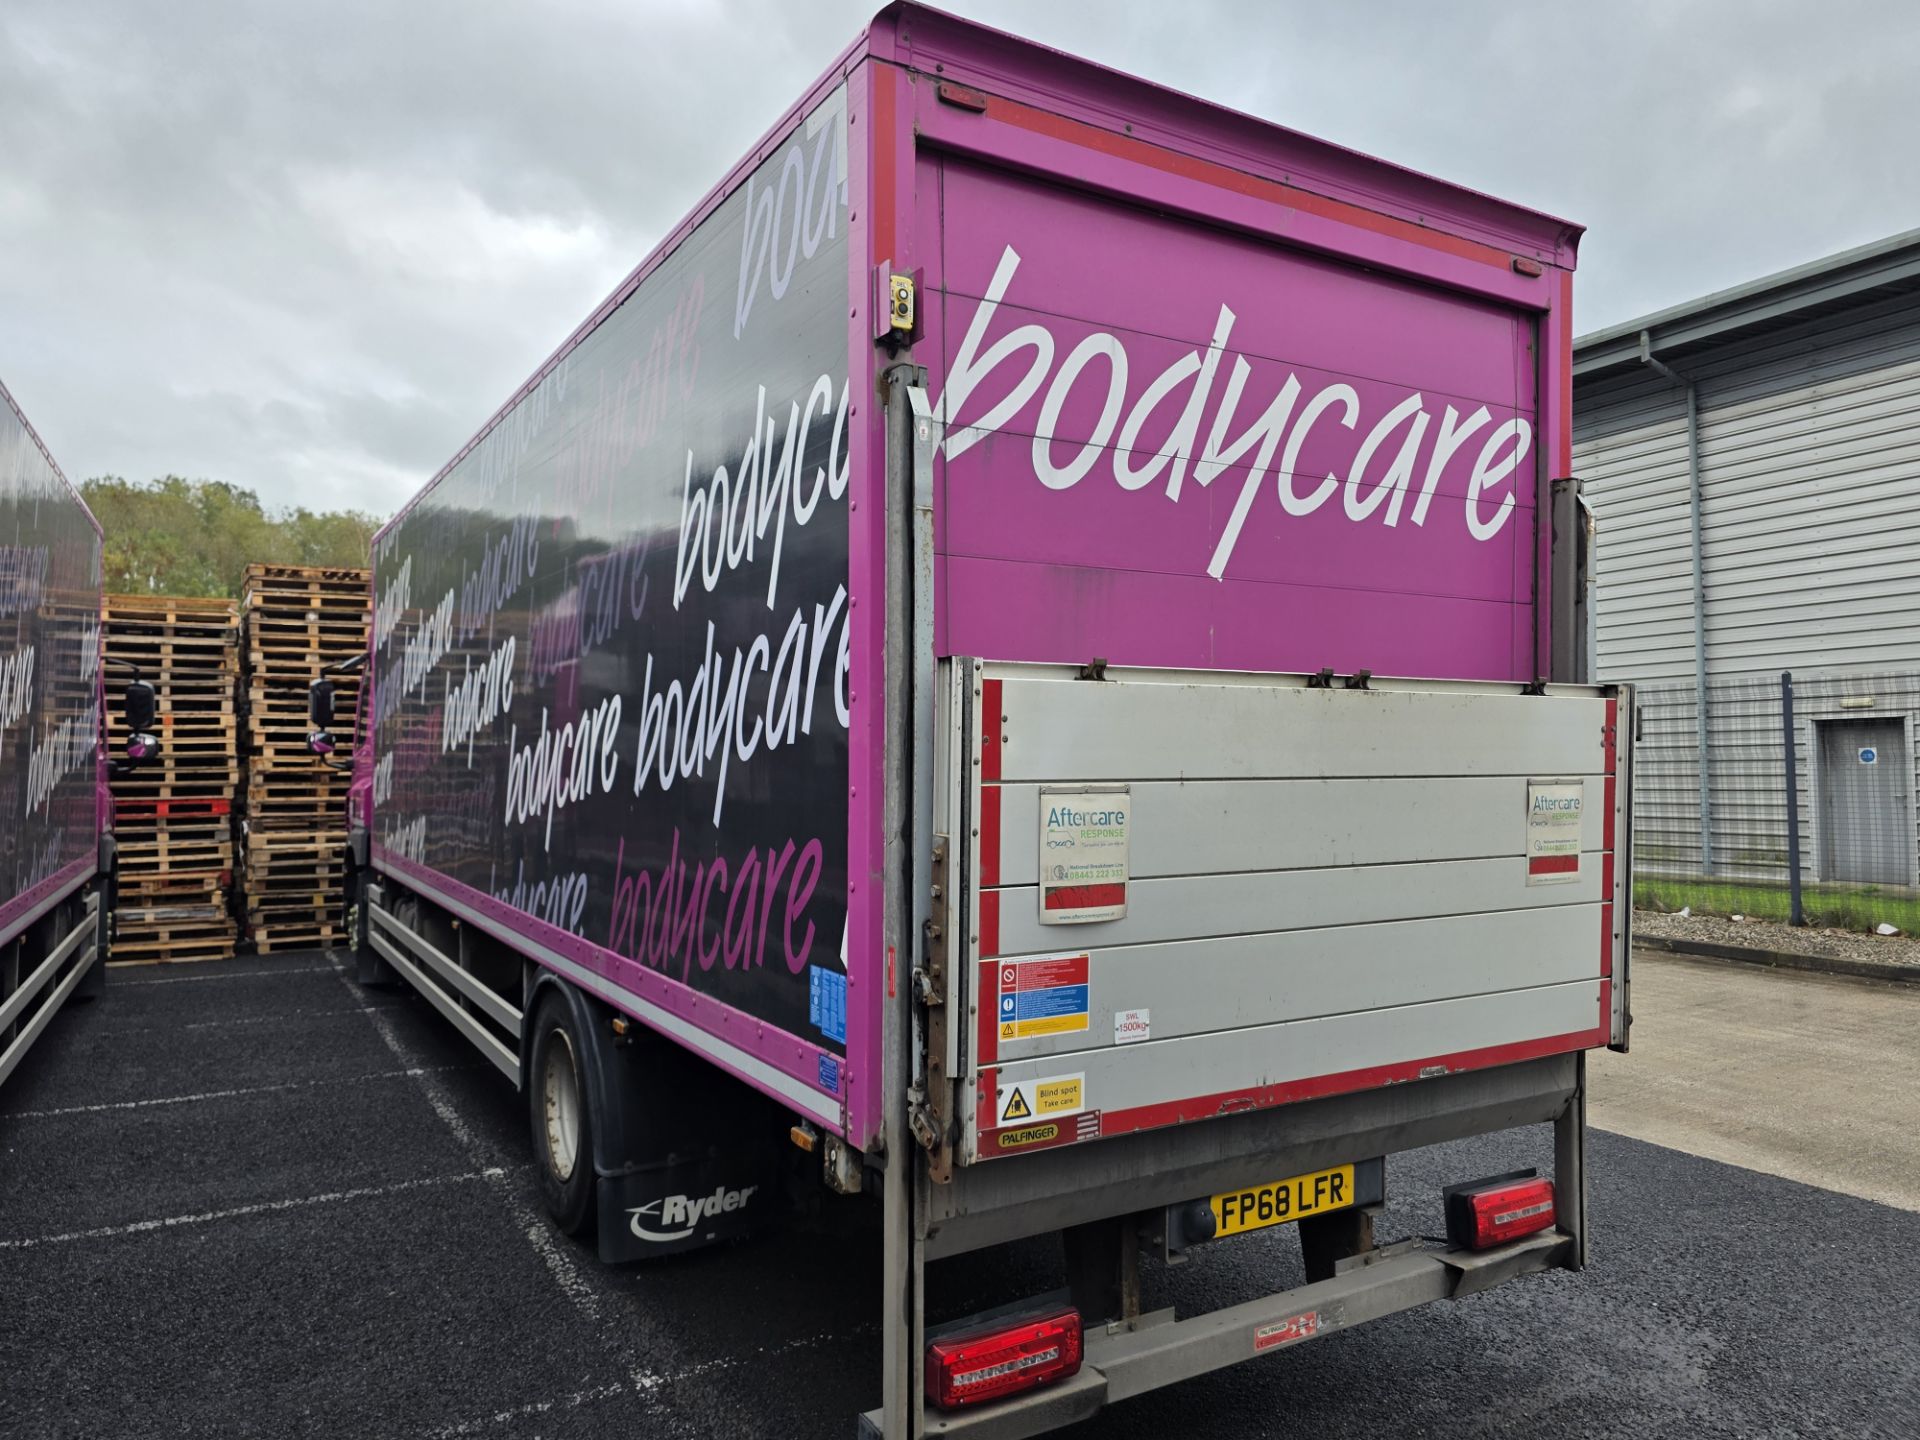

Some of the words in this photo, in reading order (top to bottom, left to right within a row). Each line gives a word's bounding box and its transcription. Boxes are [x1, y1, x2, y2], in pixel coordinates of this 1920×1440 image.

[734, 113, 849, 341] bod
[931, 244, 1531, 581] bodycare
[442, 635, 516, 770] bodycare
[505, 694, 622, 853] bodycare
[1534, 796, 1580, 811] Aftercare
[1047, 807, 1125, 827] Aftercare
[1080, 828, 1125, 838] RESPONSE
[608, 825, 823, 986] bodycare
[1126, 1012, 1139, 1021] SWL
[1119, 1022, 1147, 1032] 1500kg
[1040, 1088, 1059, 1098] Blind
[1060, 1085, 1078, 1096] spot
[1043, 1099, 1059, 1108] Take
[1060, 1097, 1074, 1105] care
[1002, 1126, 1055, 1145] PALFINGER
[661, 1186, 754, 1227] Ryder
[1222, 1185, 1290, 1230] FP68
[1298, 1172, 1344, 1212] LFR
